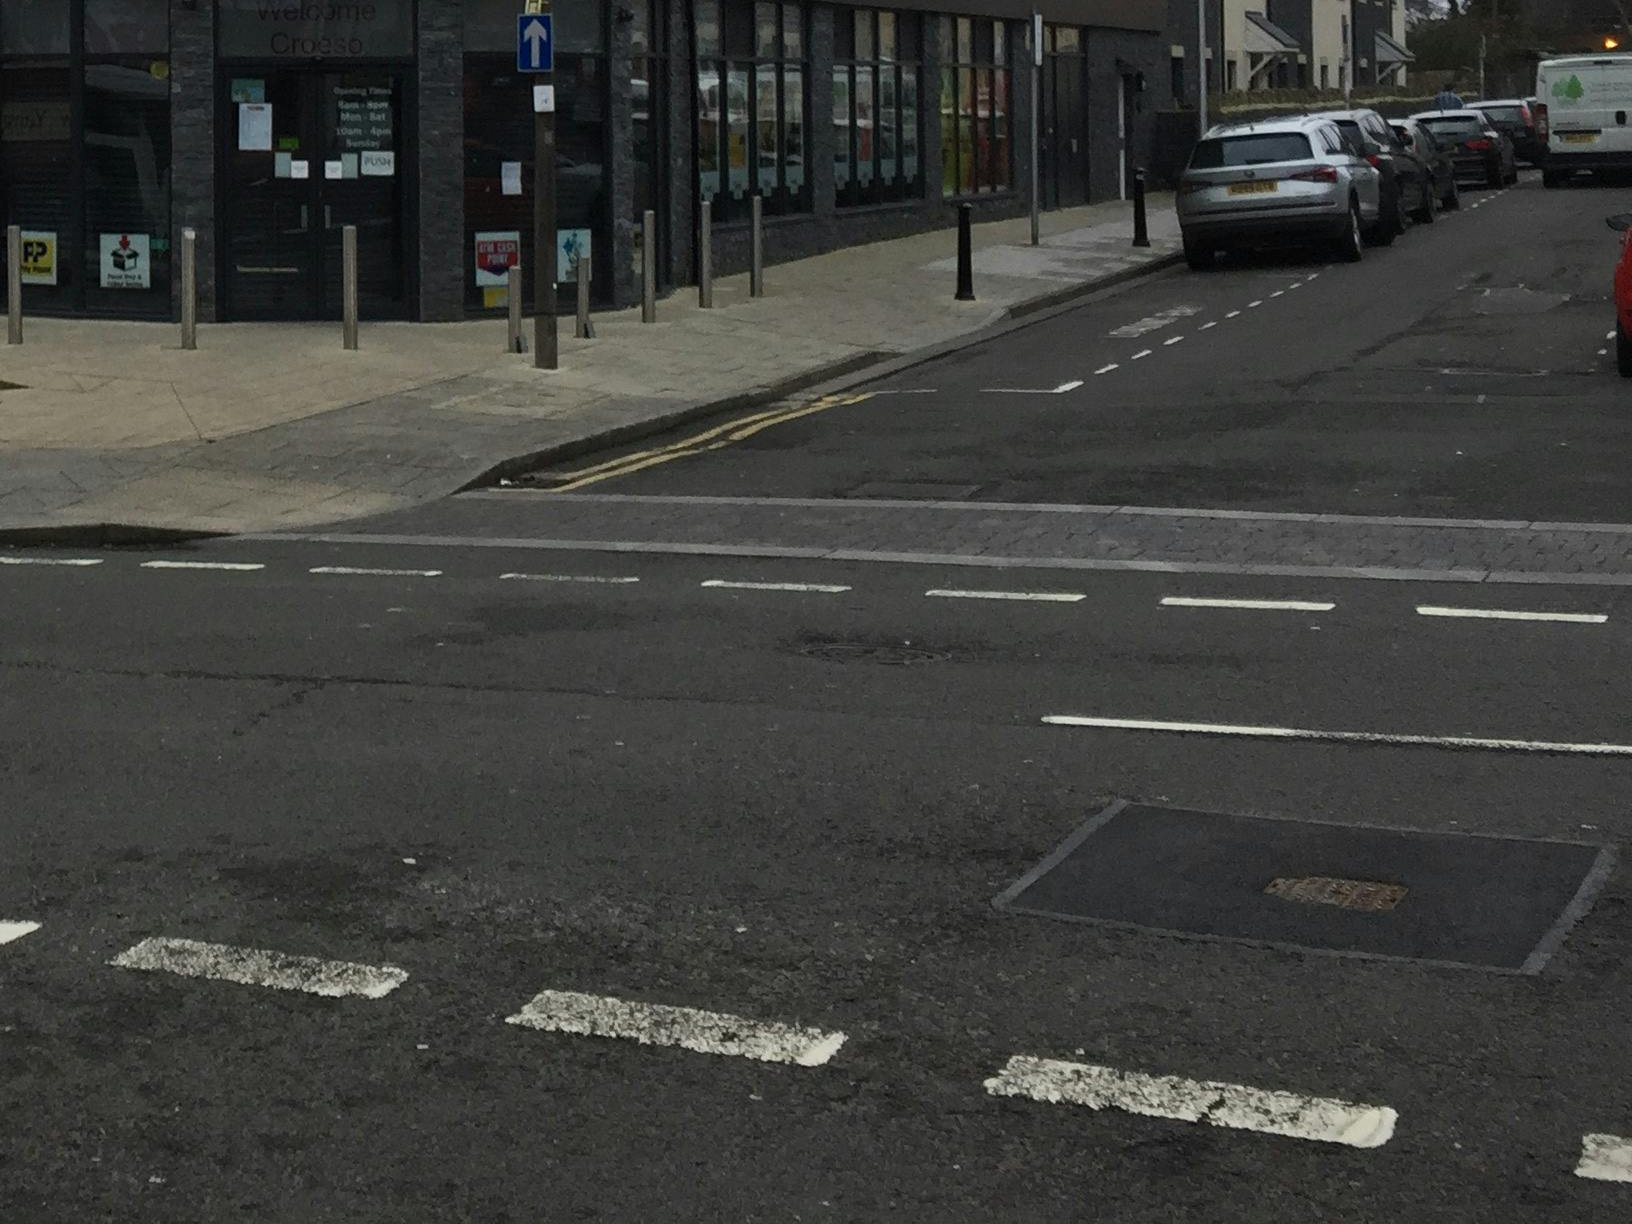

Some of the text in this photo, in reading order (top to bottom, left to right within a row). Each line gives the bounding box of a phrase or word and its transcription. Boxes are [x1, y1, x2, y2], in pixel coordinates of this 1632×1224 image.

[257, 0, 376, 21] Welcome
[269, 31, 363, 55] Croeso
[340, 112, 362, 121] Mon
[336, 127, 362, 136] 10am
[370, 127, 392, 137] 4pm
[346, 138, 380, 149] Sunday
